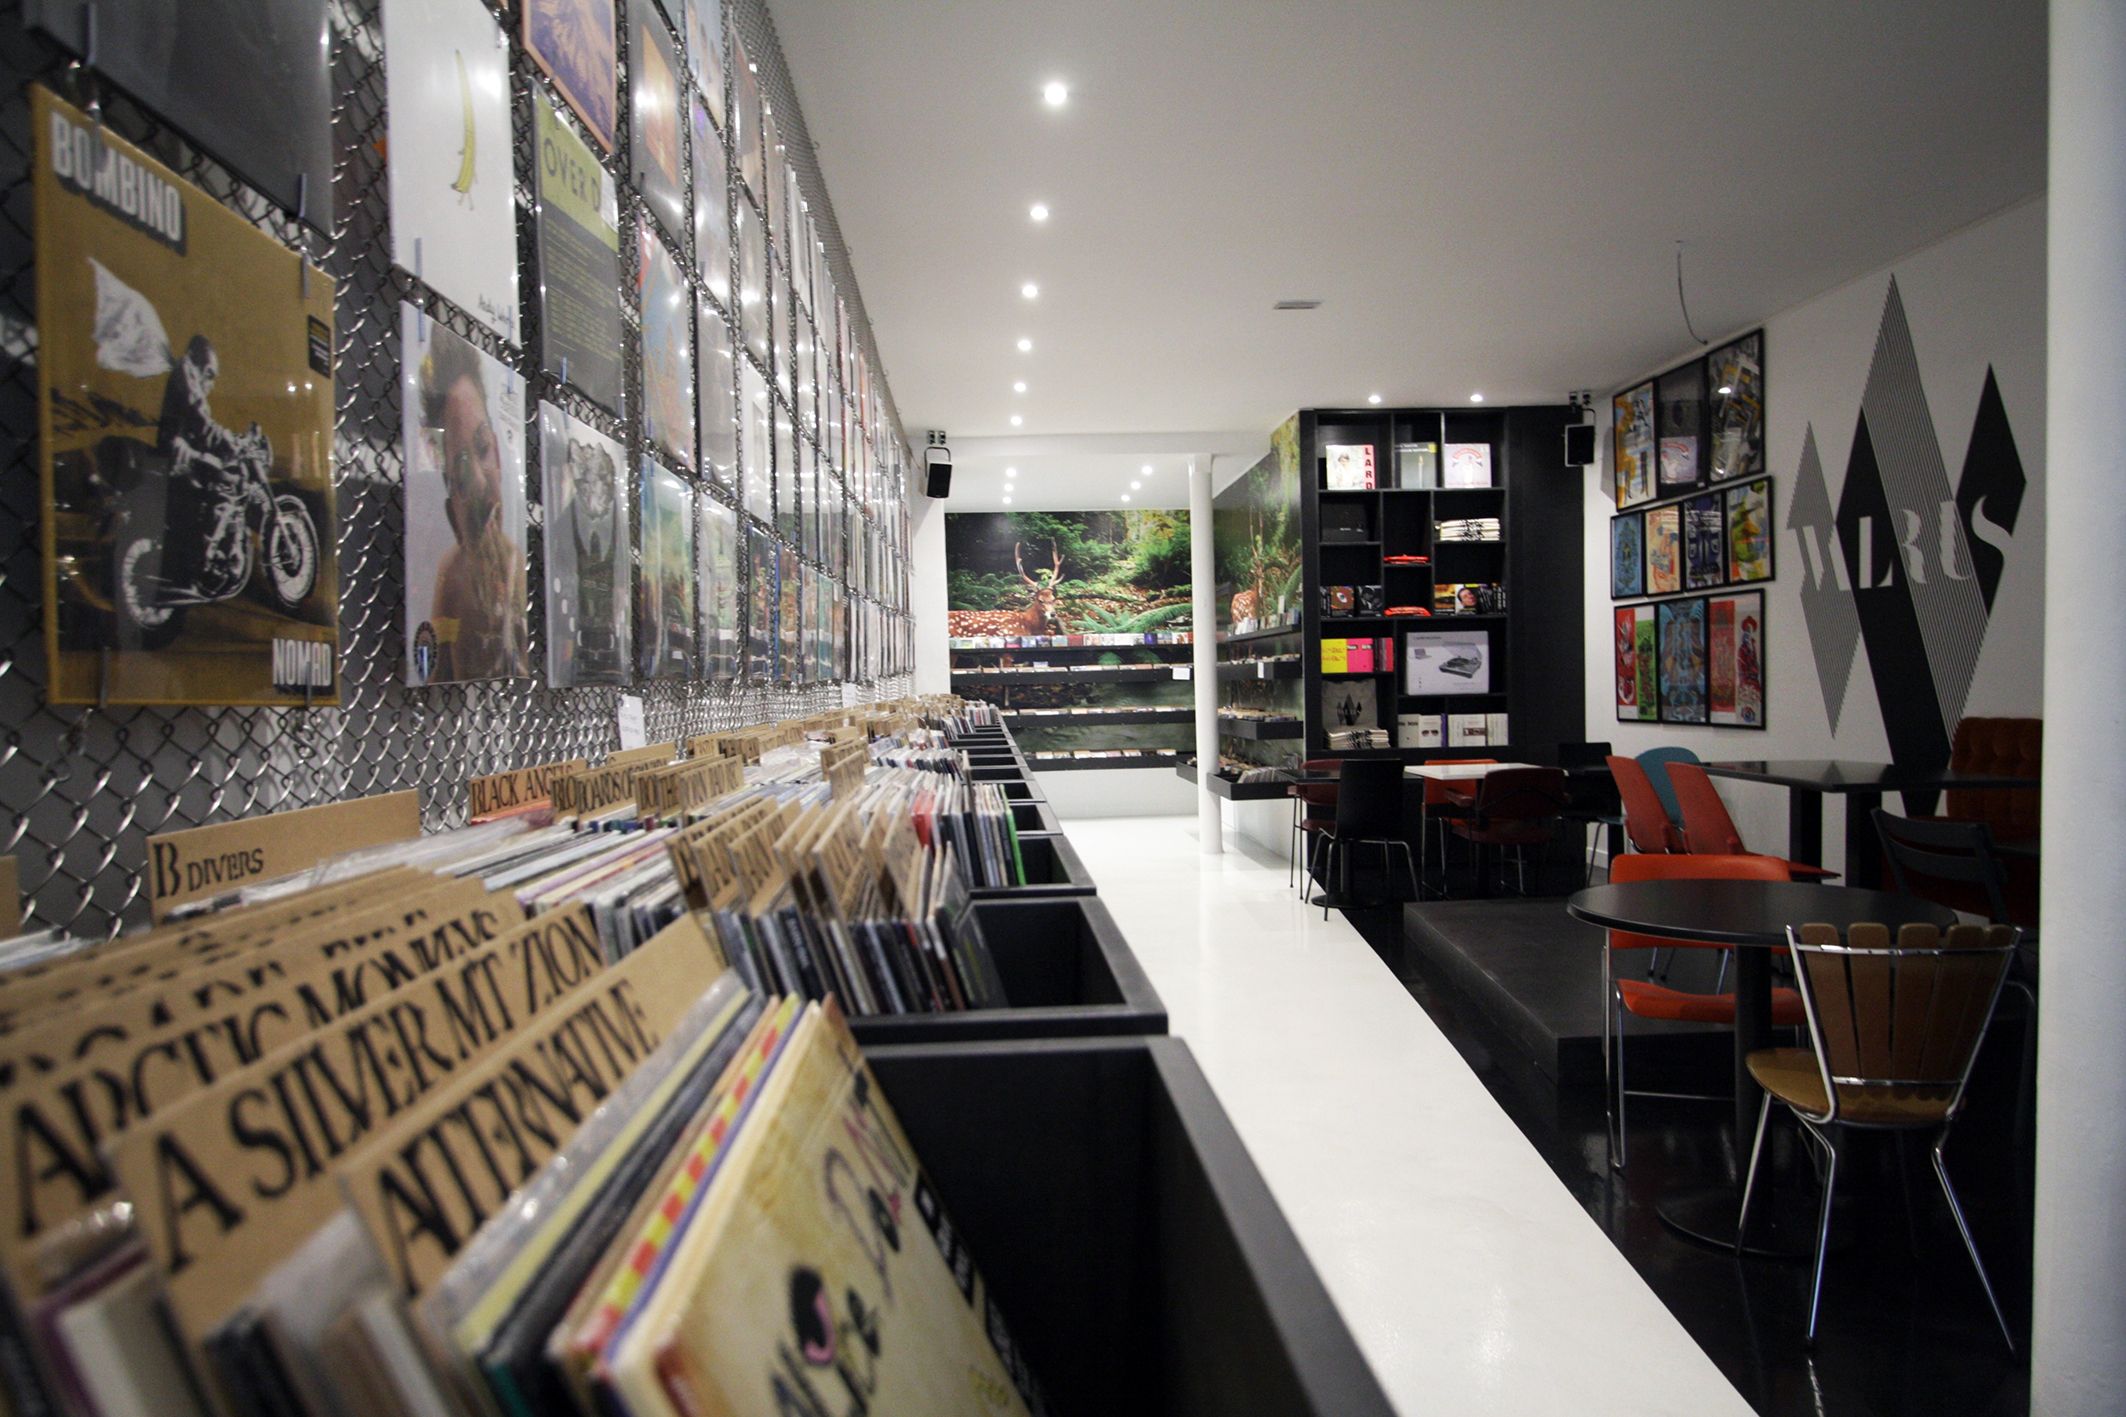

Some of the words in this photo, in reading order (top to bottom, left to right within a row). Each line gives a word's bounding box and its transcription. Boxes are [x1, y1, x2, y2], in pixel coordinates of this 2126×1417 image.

[51, 111, 183, 243] BOMBINO
[1364, 447, 1373, 490] LARD
[272, 638, 332, 687] NOMAD
[471, 773, 520, 817] BLACK
[153, 842, 180, 898] B
[187, 847, 264, 892] DIVERS
[155, 1130, 246, 1277] A
[227, 1000, 454, 1200] SILVER
[434, 948, 515, 1060] MT
[502, 901, 606, 1017] ZION
[379, 977, 660, 1297] ALTERNATIVE
